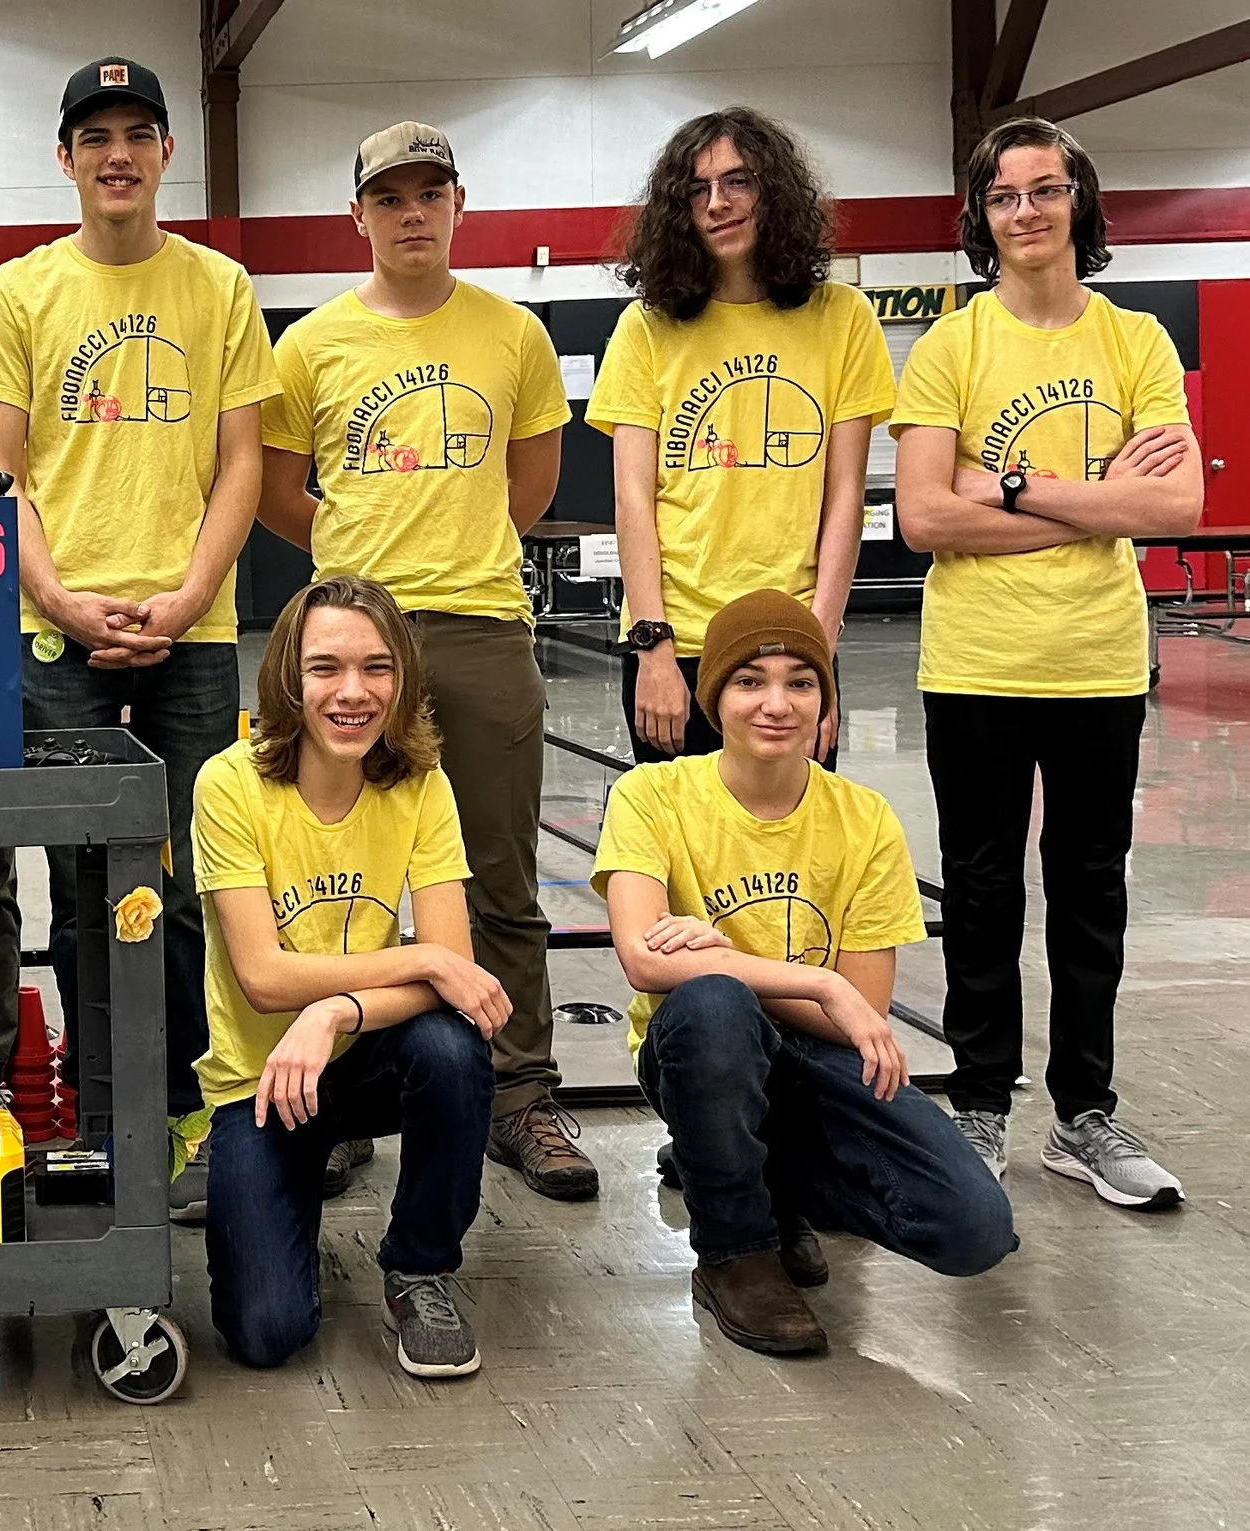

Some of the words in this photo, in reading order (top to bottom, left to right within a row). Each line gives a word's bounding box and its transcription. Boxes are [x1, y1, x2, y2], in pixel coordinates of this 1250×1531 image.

[61, 329, 108, 421] FIBONACCI
[109, 314, 157, 339] 14126
[343, 381, 393, 471] FIBONACCI
[395, 364, 449, 389] 14126
[666, 371, 722, 469] FIBONACCI
[723, 354, 778, 378] 14126
[981, 393, 1035, 474] BONACCI
[1036, 378, 1094, 404] 14126
[35, 641, 57, 658] DRIVER
[740, 872, 799, 897] 14126
